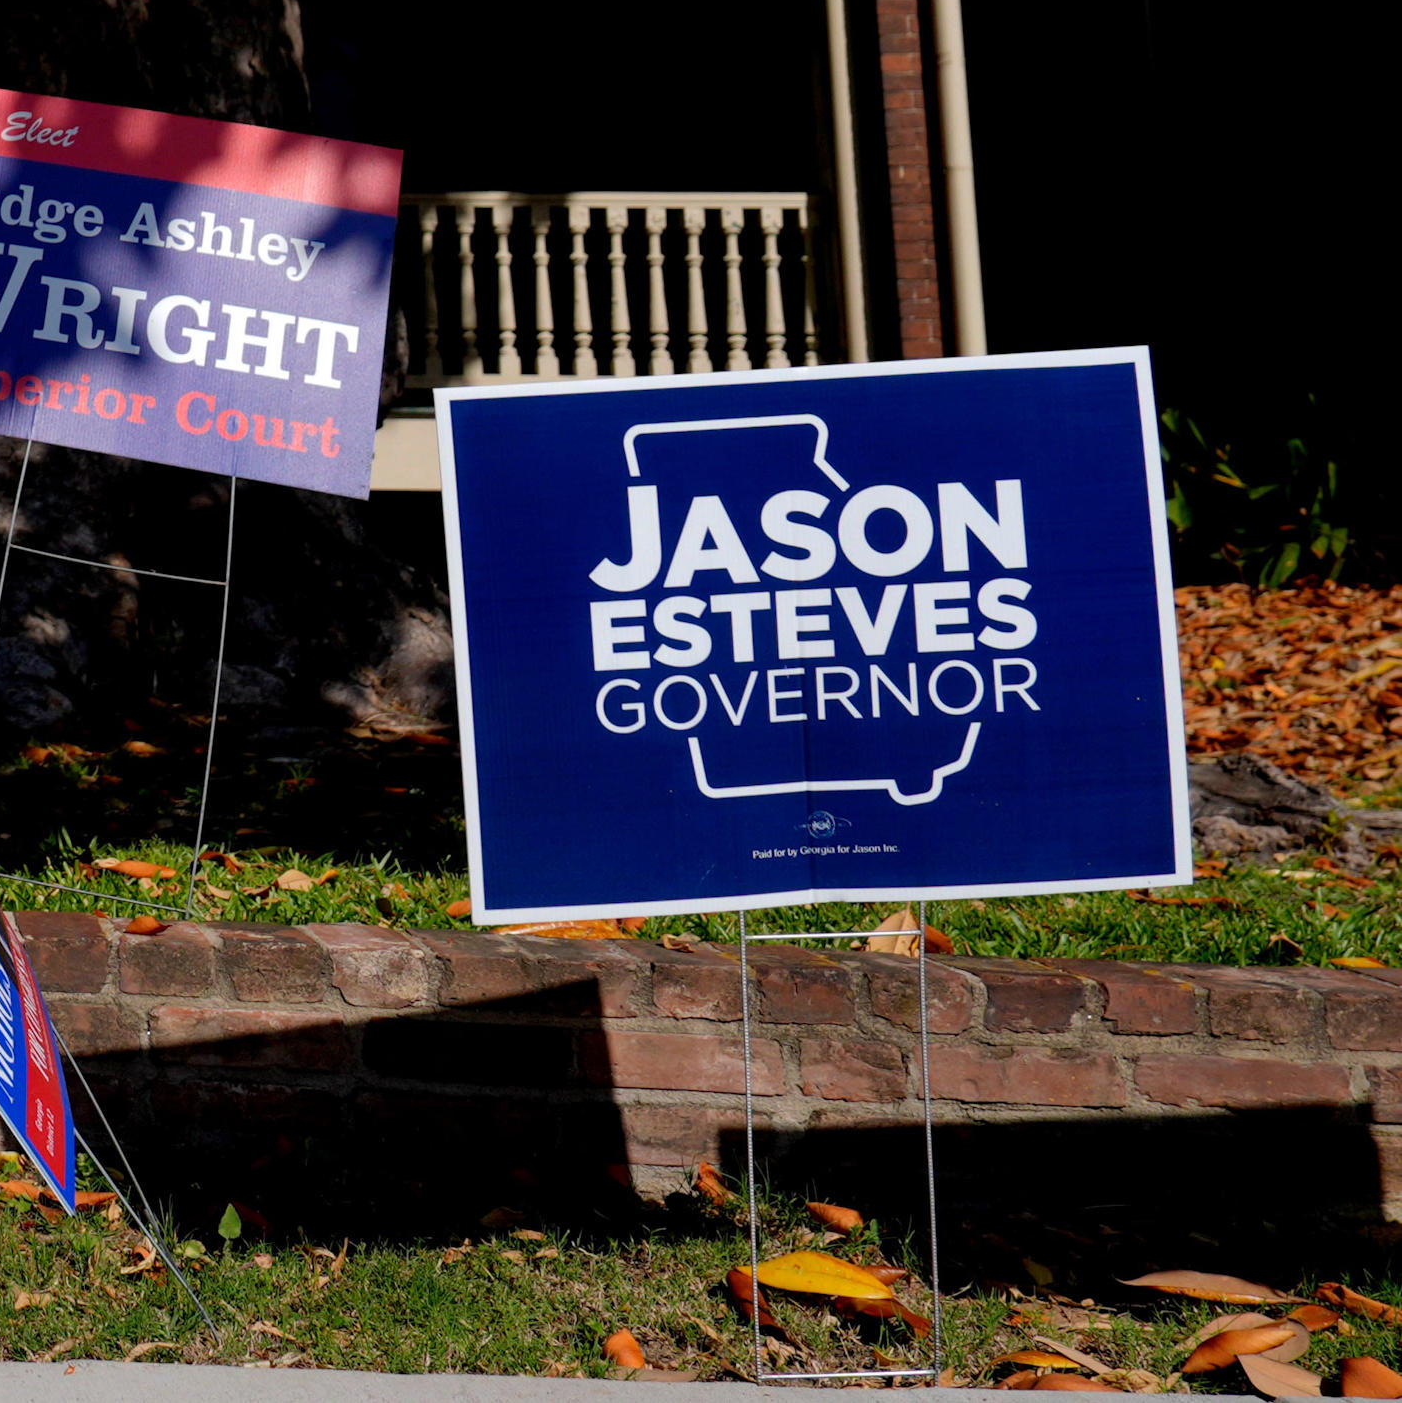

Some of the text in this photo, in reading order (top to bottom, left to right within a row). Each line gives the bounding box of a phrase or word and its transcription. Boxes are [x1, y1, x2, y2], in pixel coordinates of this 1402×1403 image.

[119, 201, 325, 282] Ashley
[175, 391, 341, 458] Court
[588, 478, 1029, 593] JASON
[590, 578, 1039, 672] ESTEVES
[595, 657, 1042, 734] GOVERNOR
[752, 844, 900, 860] Paid for by Georgia for Jason Inc.
